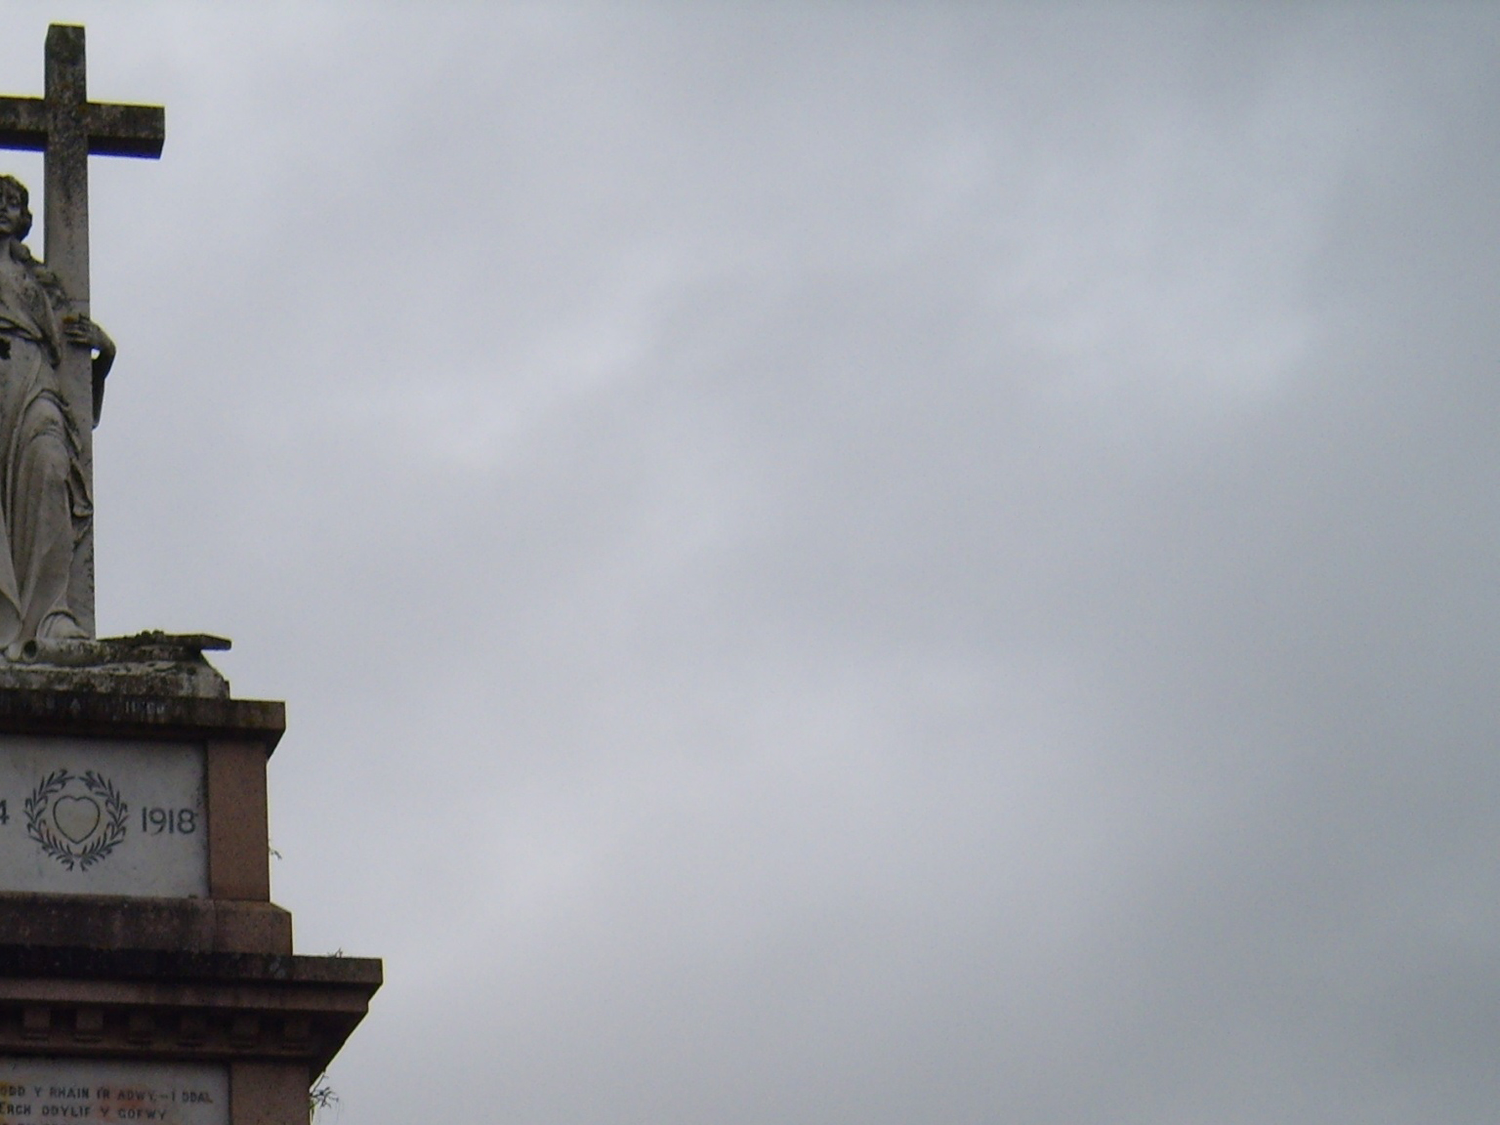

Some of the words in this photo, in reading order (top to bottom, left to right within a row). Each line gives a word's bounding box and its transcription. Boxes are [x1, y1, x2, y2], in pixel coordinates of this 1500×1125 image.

[142, 807, 196, 834] 1918
[34, 1086, 42, 1096] Y
[50, 1087, 89, 1098] RHAIN
[100, 1106, 110, 1116] Y
[118, 1109, 167, 1120] GOFWY
